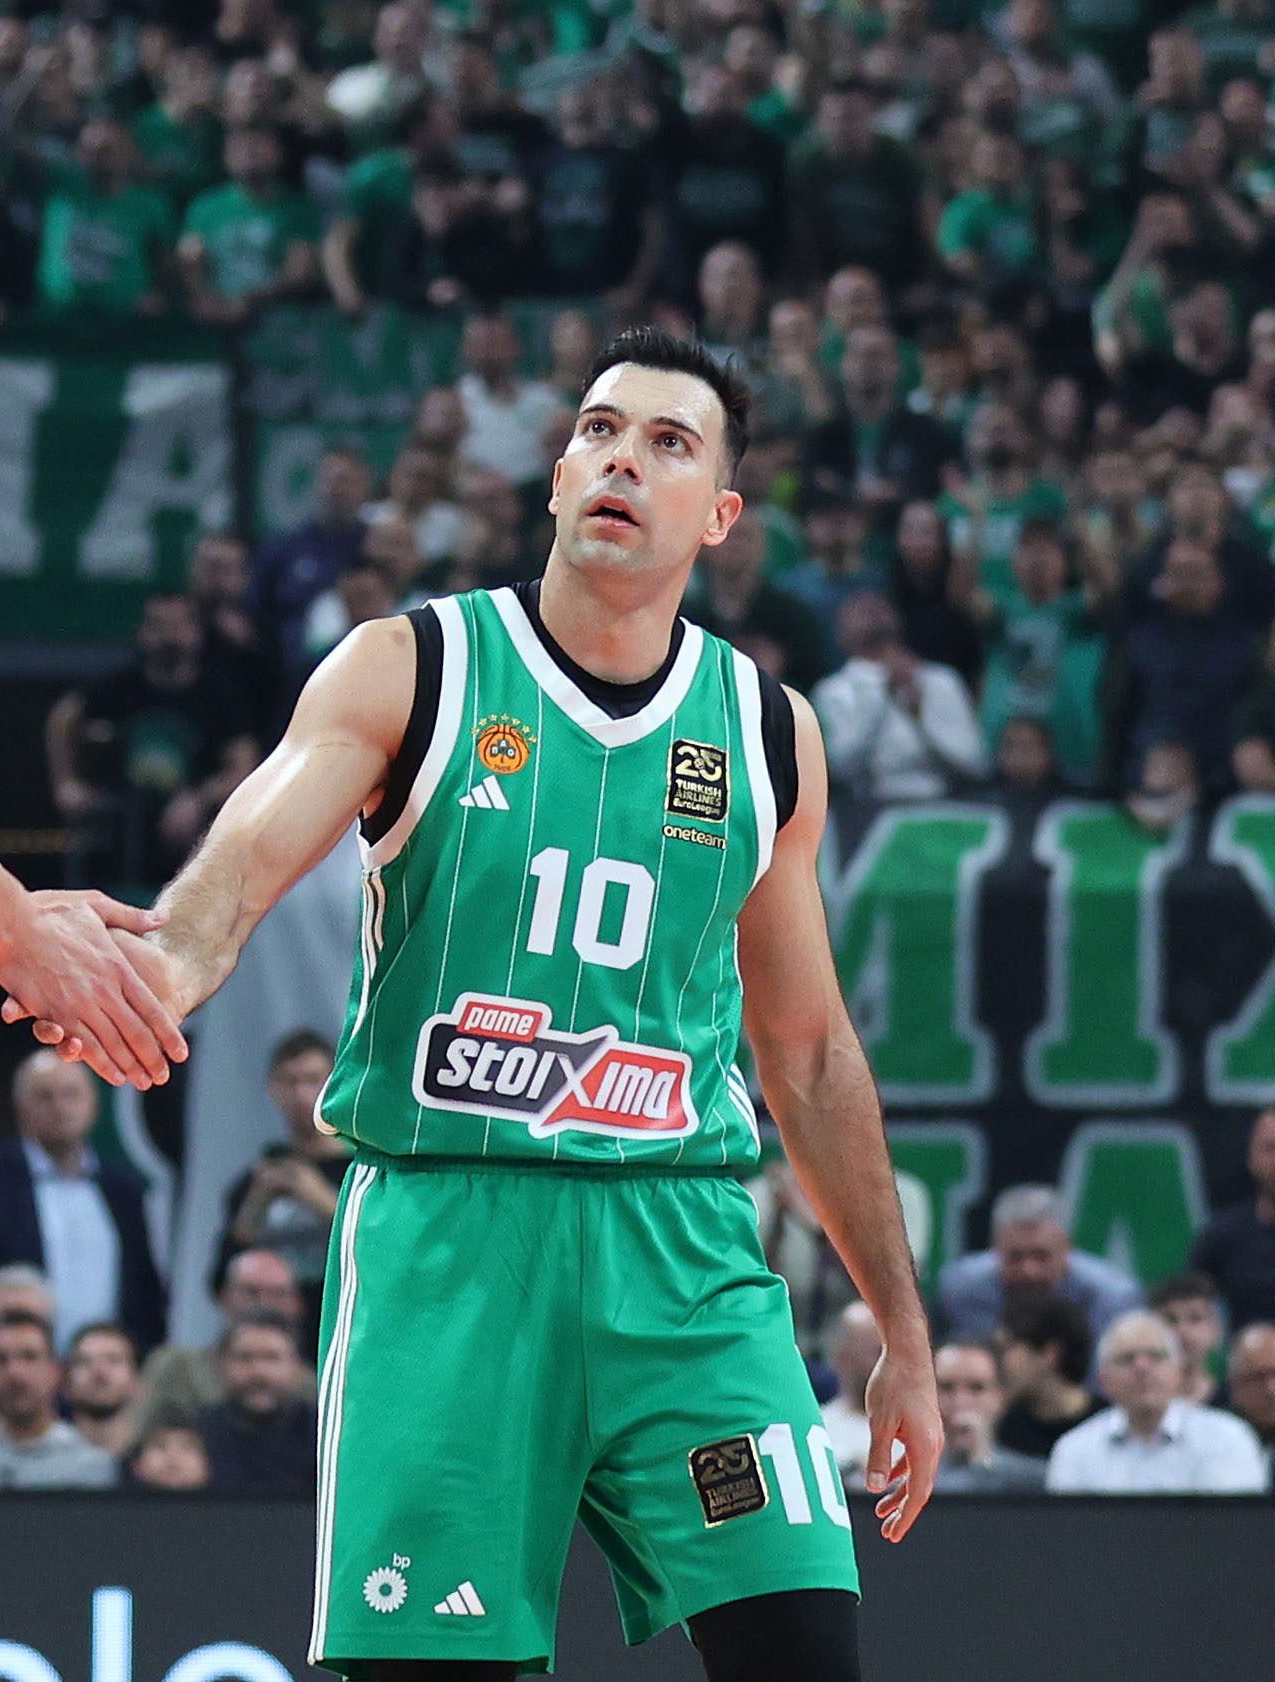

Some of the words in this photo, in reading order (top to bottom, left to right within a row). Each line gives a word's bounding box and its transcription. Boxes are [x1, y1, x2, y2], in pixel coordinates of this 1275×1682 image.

[675, 745, 723, 782] 25
[675, 778, 722, 799] TURKISH
[663, 825, 726, 849] oneteam
[526, 846, 656, 970] 10
[465, 1005, 535, 1036] pame
[757, 1422, 853, 1530] 10
[392, 1551, 412, 1571] bp
